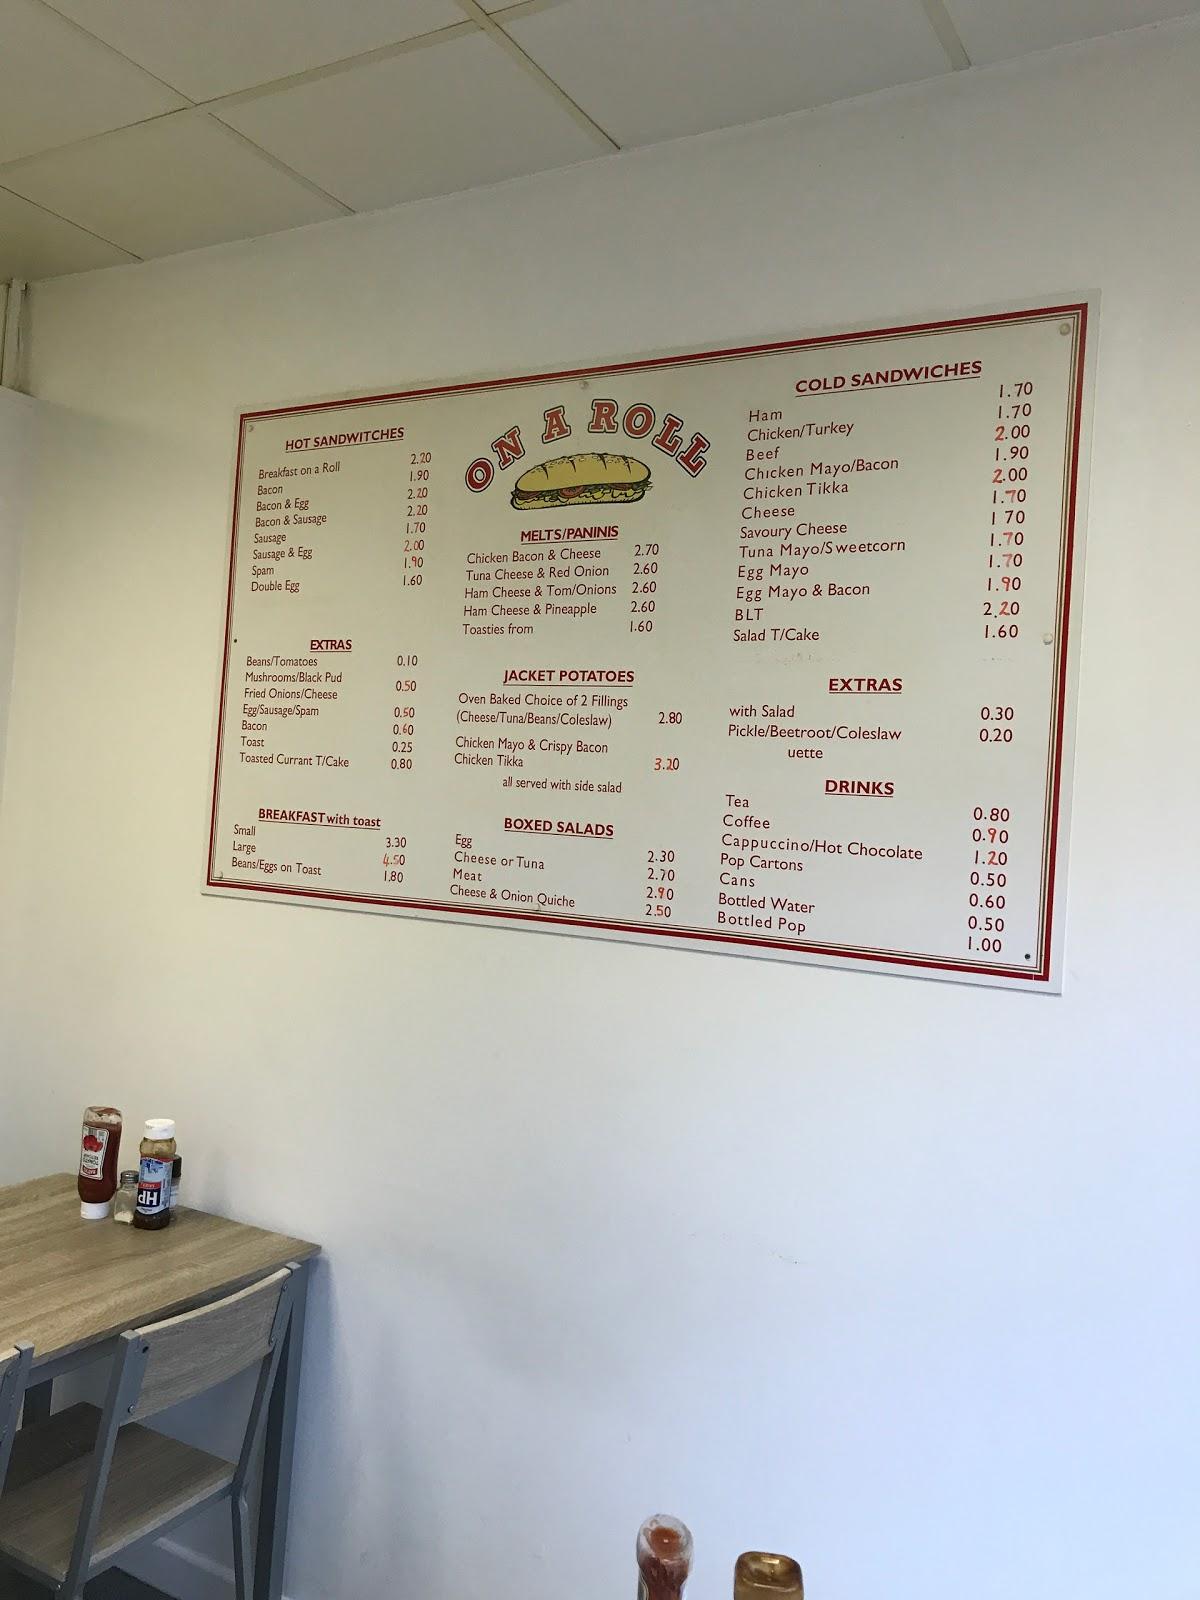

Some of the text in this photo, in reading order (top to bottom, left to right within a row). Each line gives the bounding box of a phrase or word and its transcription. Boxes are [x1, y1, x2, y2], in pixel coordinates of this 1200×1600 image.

[796, 361, 982, 393] COLD SANDWICHES
[1000, 382, 1033, 398] 1.70
[749, 410, 782, 422] Ham
[999, 403, 1031, 419] 1.70
[286, 427, 404, 450] HOT SANDWITCHES
[748, 422, 854, 441] Chicken/Turkey
[465, 399, 710, 493] ON A ROLL
[746, 446, 780, 461] Beef
[996, 446, 1029, 461] 1.90
[259, 462, 340, 479] Breakfast Roll
[745, 459, 898, 480] Chicken Mayo/Bacon
[992, 469, 1027, 483] 2.00
[258, 485, 283, 495] Bacon
[744, 482, 848, 500] Chicken Tikka
[257, 499, 309, 511] Bacon Egg
[742, 506, 794, 519] Cheese
[256, 514, 327, 527] Bacon Sausage
[254, 533, 286, 544] Sausage
[521, 526, 618, 542] MELTS/PANINIS
[740, 523, 847, 540] Savoury Cheese
[253, 547, 312, 560] Sausage Egg
[467, 549, 600, 564] Chicken Bacon Cheese
[635, 544, 659, 556] 2.70
[739, 546, 773, 558] Tuna
[252, 565, 274, 577] Spam
[466, 566, 609, 581] Tuna Cheese Red Onion
[634, 563, 658, 574] 2.60
[738, 564, 808, 581] Egg Mayo
[251, 580, 300, 593] Double Egg
[403, 575, 422, 586] 1.60
[632, 582, 656, 593] 2.60
[988, 577, 1021, 591] 1.90
[465, 584, 616, 598] Ham Cheese Tom/Onions
[737, 583, 869, 602] Egg Mayo Bacon
[464, 603, 597, 617] Ham Cheese Pineapple
[631, 601, 655, 612] 2.60
[984, 601, 1019, 618] 2.20
[735, 608, 763, 621] BLT
[463, 623, 533, 635] Toasties from
[630, 621, 652, 632] 1.60
[985, 625, 1018, 638] 1.60
[733, 628, 819, 641] Salad T/Cake
[310, 640, 352, 650] EXTRAS
[247, 656, 318, 666] Beans/Tomatoes
[397, 655, 418, 666] 0.10
[245, 672, 342, 682] Mushrooms/Black Pud
[504, 670, 634, 683] JACKET POTATOES
[829, 678, 902, 691] EXTRAS
[245, 689, 337, 699] Fried Onions/Cheese
[459, 693, 628, 710] Oven Baked Choice Fillings
[243, 704, 319, 717] Egg/Sausage/Spam
[729, 705, 794, 717] with Salad
[981, 707, 1014, 720] 0.30
[457, 711, 611, 729] (Cheese/Tuna/Beans/Coleslaw)
[659, 712, 682, 724] 2.80
[242, 720, 267, 731] Bacon
[729, 725, 901, 740] Pickle/Beetroot/Coleslaw
[241, 737, 264, 747] Toast
[980, 728, 1012, 742] 0.20
[392, 742, 412, 753] 0.25
[456, 737, 608, 755] Chicken Mayo Crispy Bacon
[240, 753, 349, 767] Toasted Currant T/Cake
[391, 759, 412, 770] 0.80
[455, 754, 523, 767] Chicken Tikka
[503, 777, 622, 793] all served with side salad
[825, 780, 894, 795] DRINKS
[725, 794, 749, 808] Tea
[258, 809, 381, 827] BREAKFAST with toast
[723, 814, 770, 829] Coffee
[974, 807, 1009, 822] 0.80
[234, 825, 256, 836] Small
[504, 818, 613, 836] BOXED SALADS
[386, 837, 406, 848] 3.30
[456, 834, 472, 848] Egg
[972, 828, 1008, 843] 0.90
[233, 841, 256, 853] Large
[721, 834, 922, 860] Cappuccino/Hot Chocolate
[454, 852, 544, 869] Cheese Tuna
[648, 851, 674, 863] 2.30
[721, 853, 803, 871] Pop Cartons
[975, 850, 1007, 865] 1.20
[232, 858, 321, 875] Beans/Eggs Toast
[384, 871, 403, 883] 1.80
[453, 869, 482, 881] Meat
[648, 868, 674, 881] 2.70
[720, 873, 754, 887] Cans
[970, 872, 1006, 887] 0.50
[450, 885, 575, 907] Cheese Onion Quiche
[719, 893, 815, 913] Bottled Water
[969, 894, 1005, 909] 0.60
[718, 912, 805, 934] Bottled Pop
[968, 916, 1004, 932] 0.50
[968, 936, 1001, 952] 1.00
[138, 1191, 157, 1206] HP
